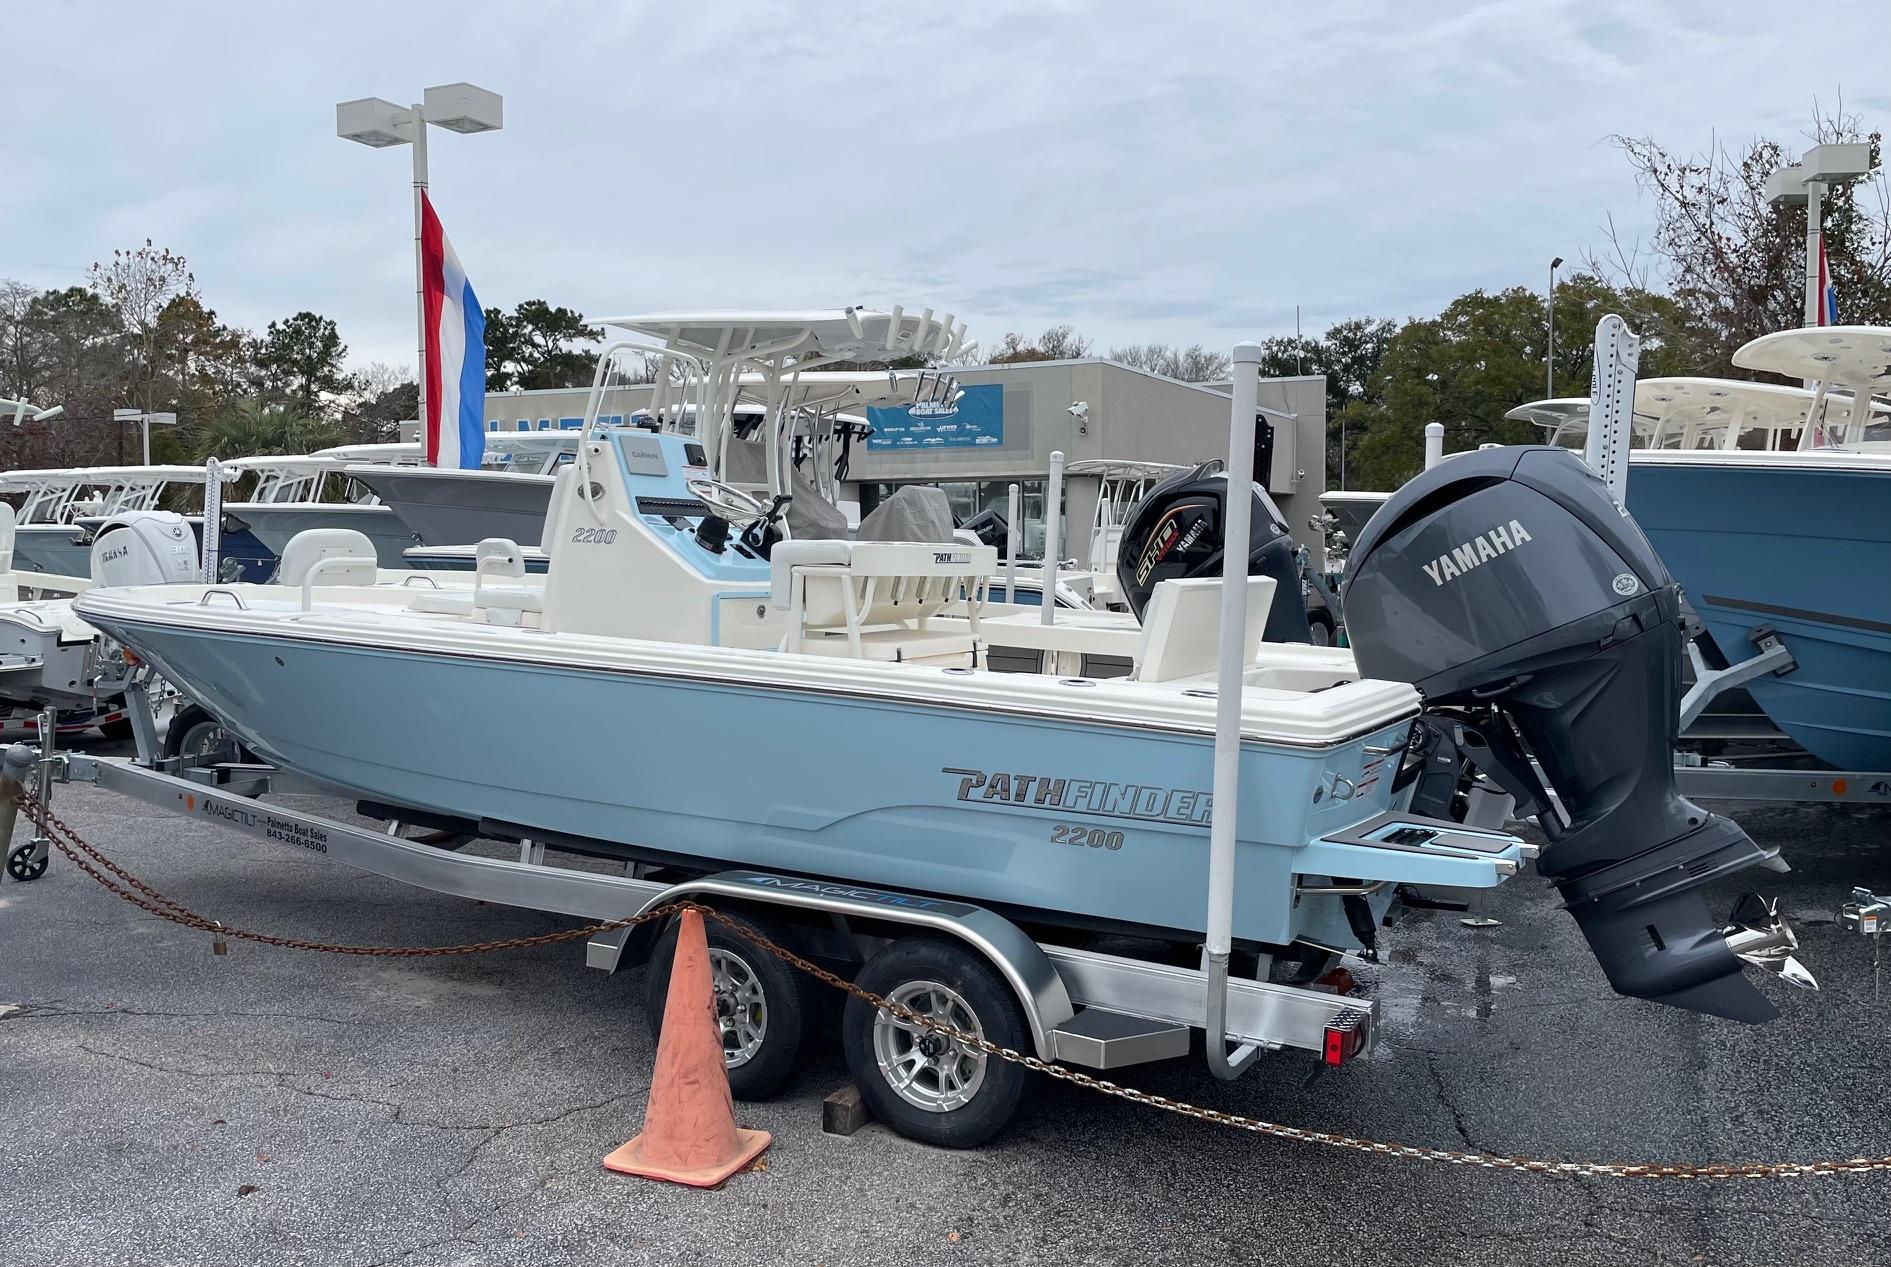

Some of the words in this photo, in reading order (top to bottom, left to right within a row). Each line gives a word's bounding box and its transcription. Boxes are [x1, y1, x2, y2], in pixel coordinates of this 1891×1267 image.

[632, 451, 659, 459] GARMIN
[571, 527, 618, 545] 2200
[1176, 519, 1208, 553] YAMAHA
[1422, 519, 1533, 587] YAMAHA
[941, 766, 1214, 829] PATHFINDER
[266, 816, 293, 833] Palmetto
[294, 823, 309, 838] Boat
[310, 828, 328, 843] Sales
[266, 828, 328, 854] 843-266-6500
[1050, 823, 1125, 851] 2200
[764, 877, 943, 910] MAGICTILT
